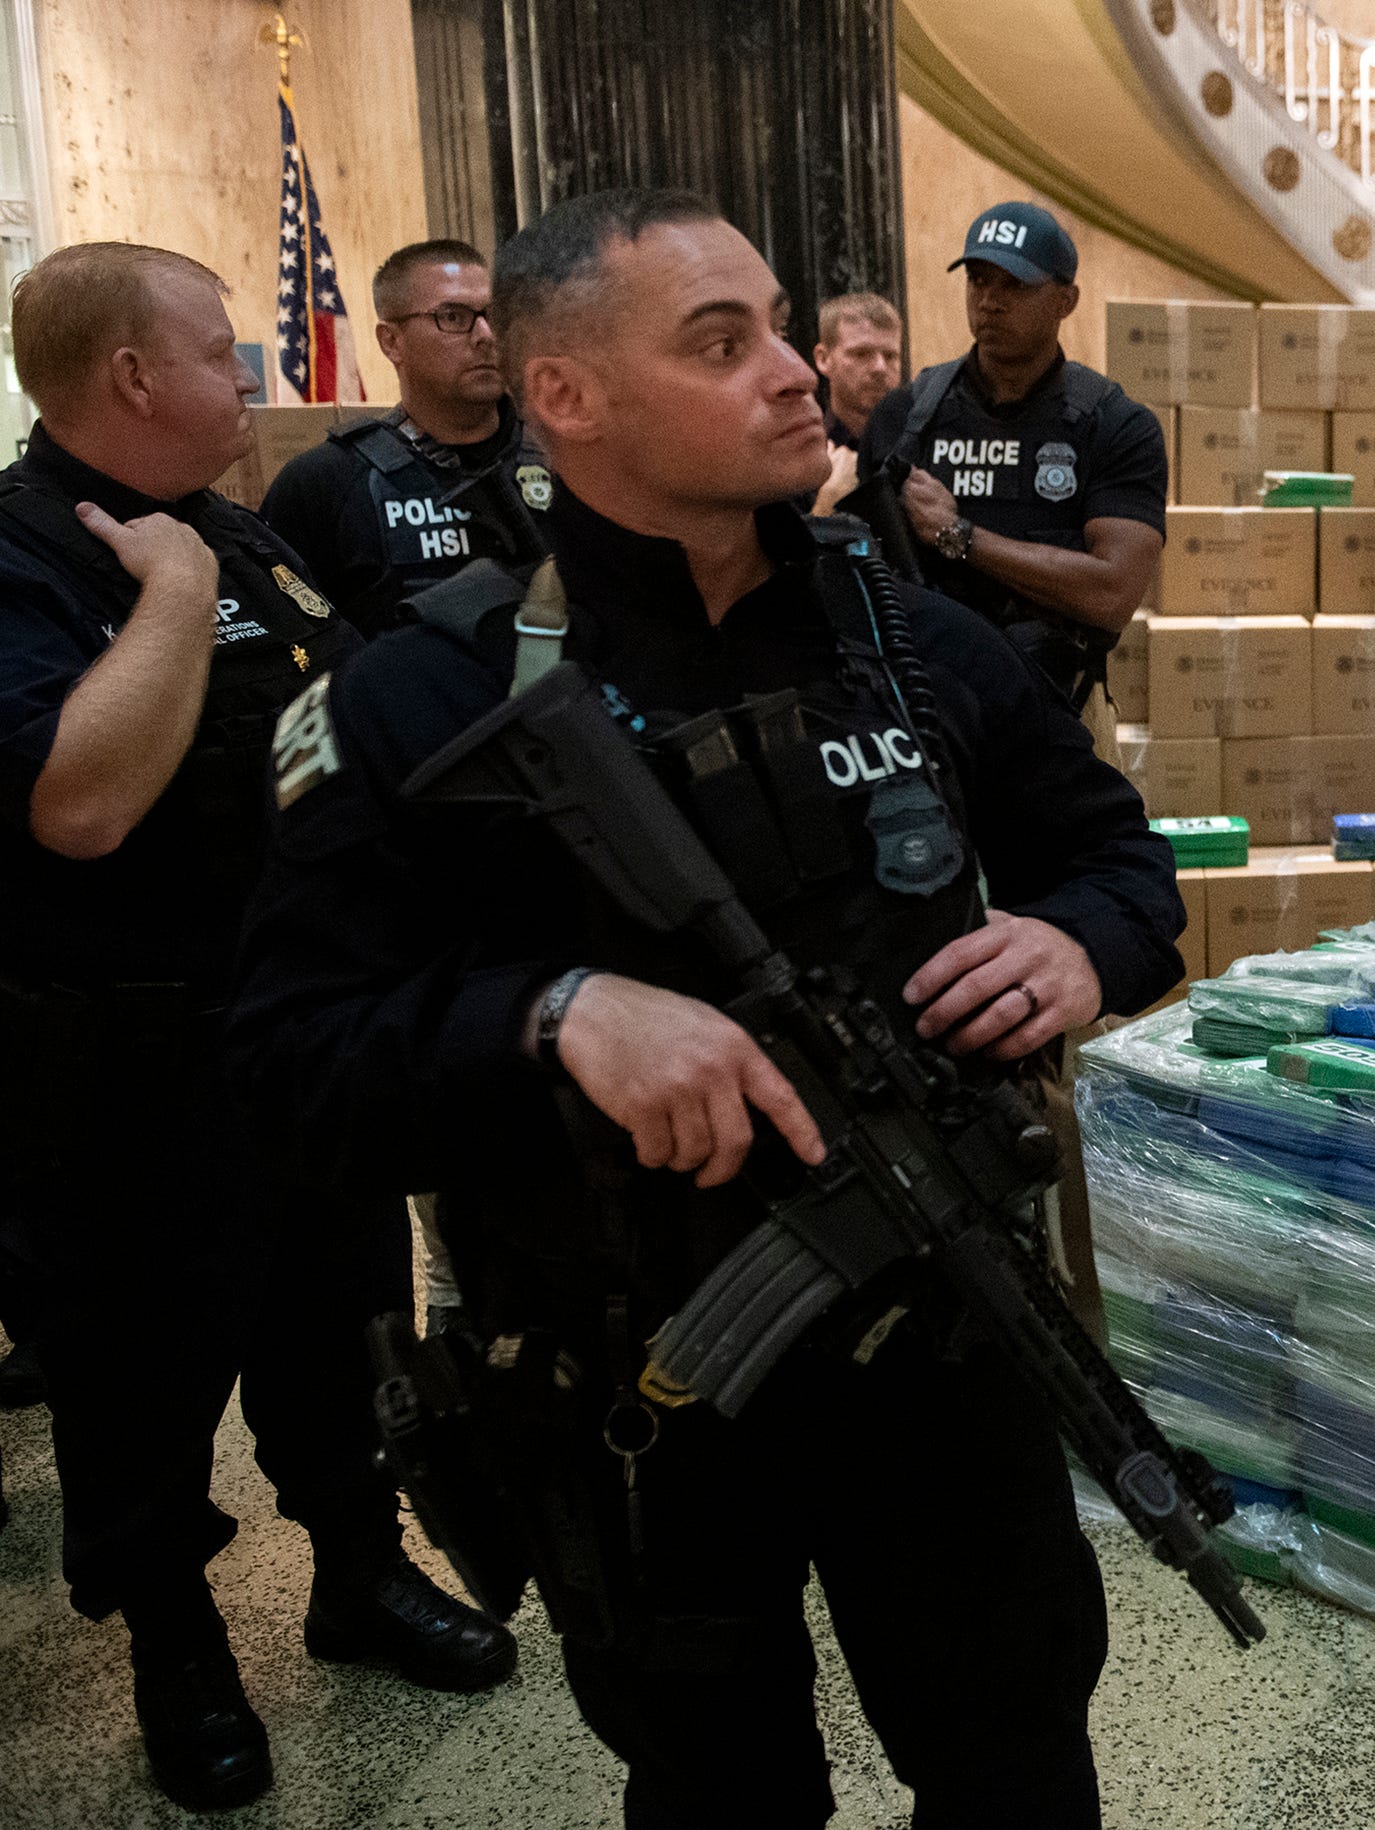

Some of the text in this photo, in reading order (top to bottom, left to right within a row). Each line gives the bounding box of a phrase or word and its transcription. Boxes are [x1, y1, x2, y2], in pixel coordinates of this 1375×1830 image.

[978, 219, 1028, 249] HSI
[933, 440, 1020, 466] POLICE
[953, 470, 994, 497] HSI
[419, 528, 471, 559] HSI
[226, 627, 269, 642] OFFICER
[819, 727, 925, 787] OLIC
